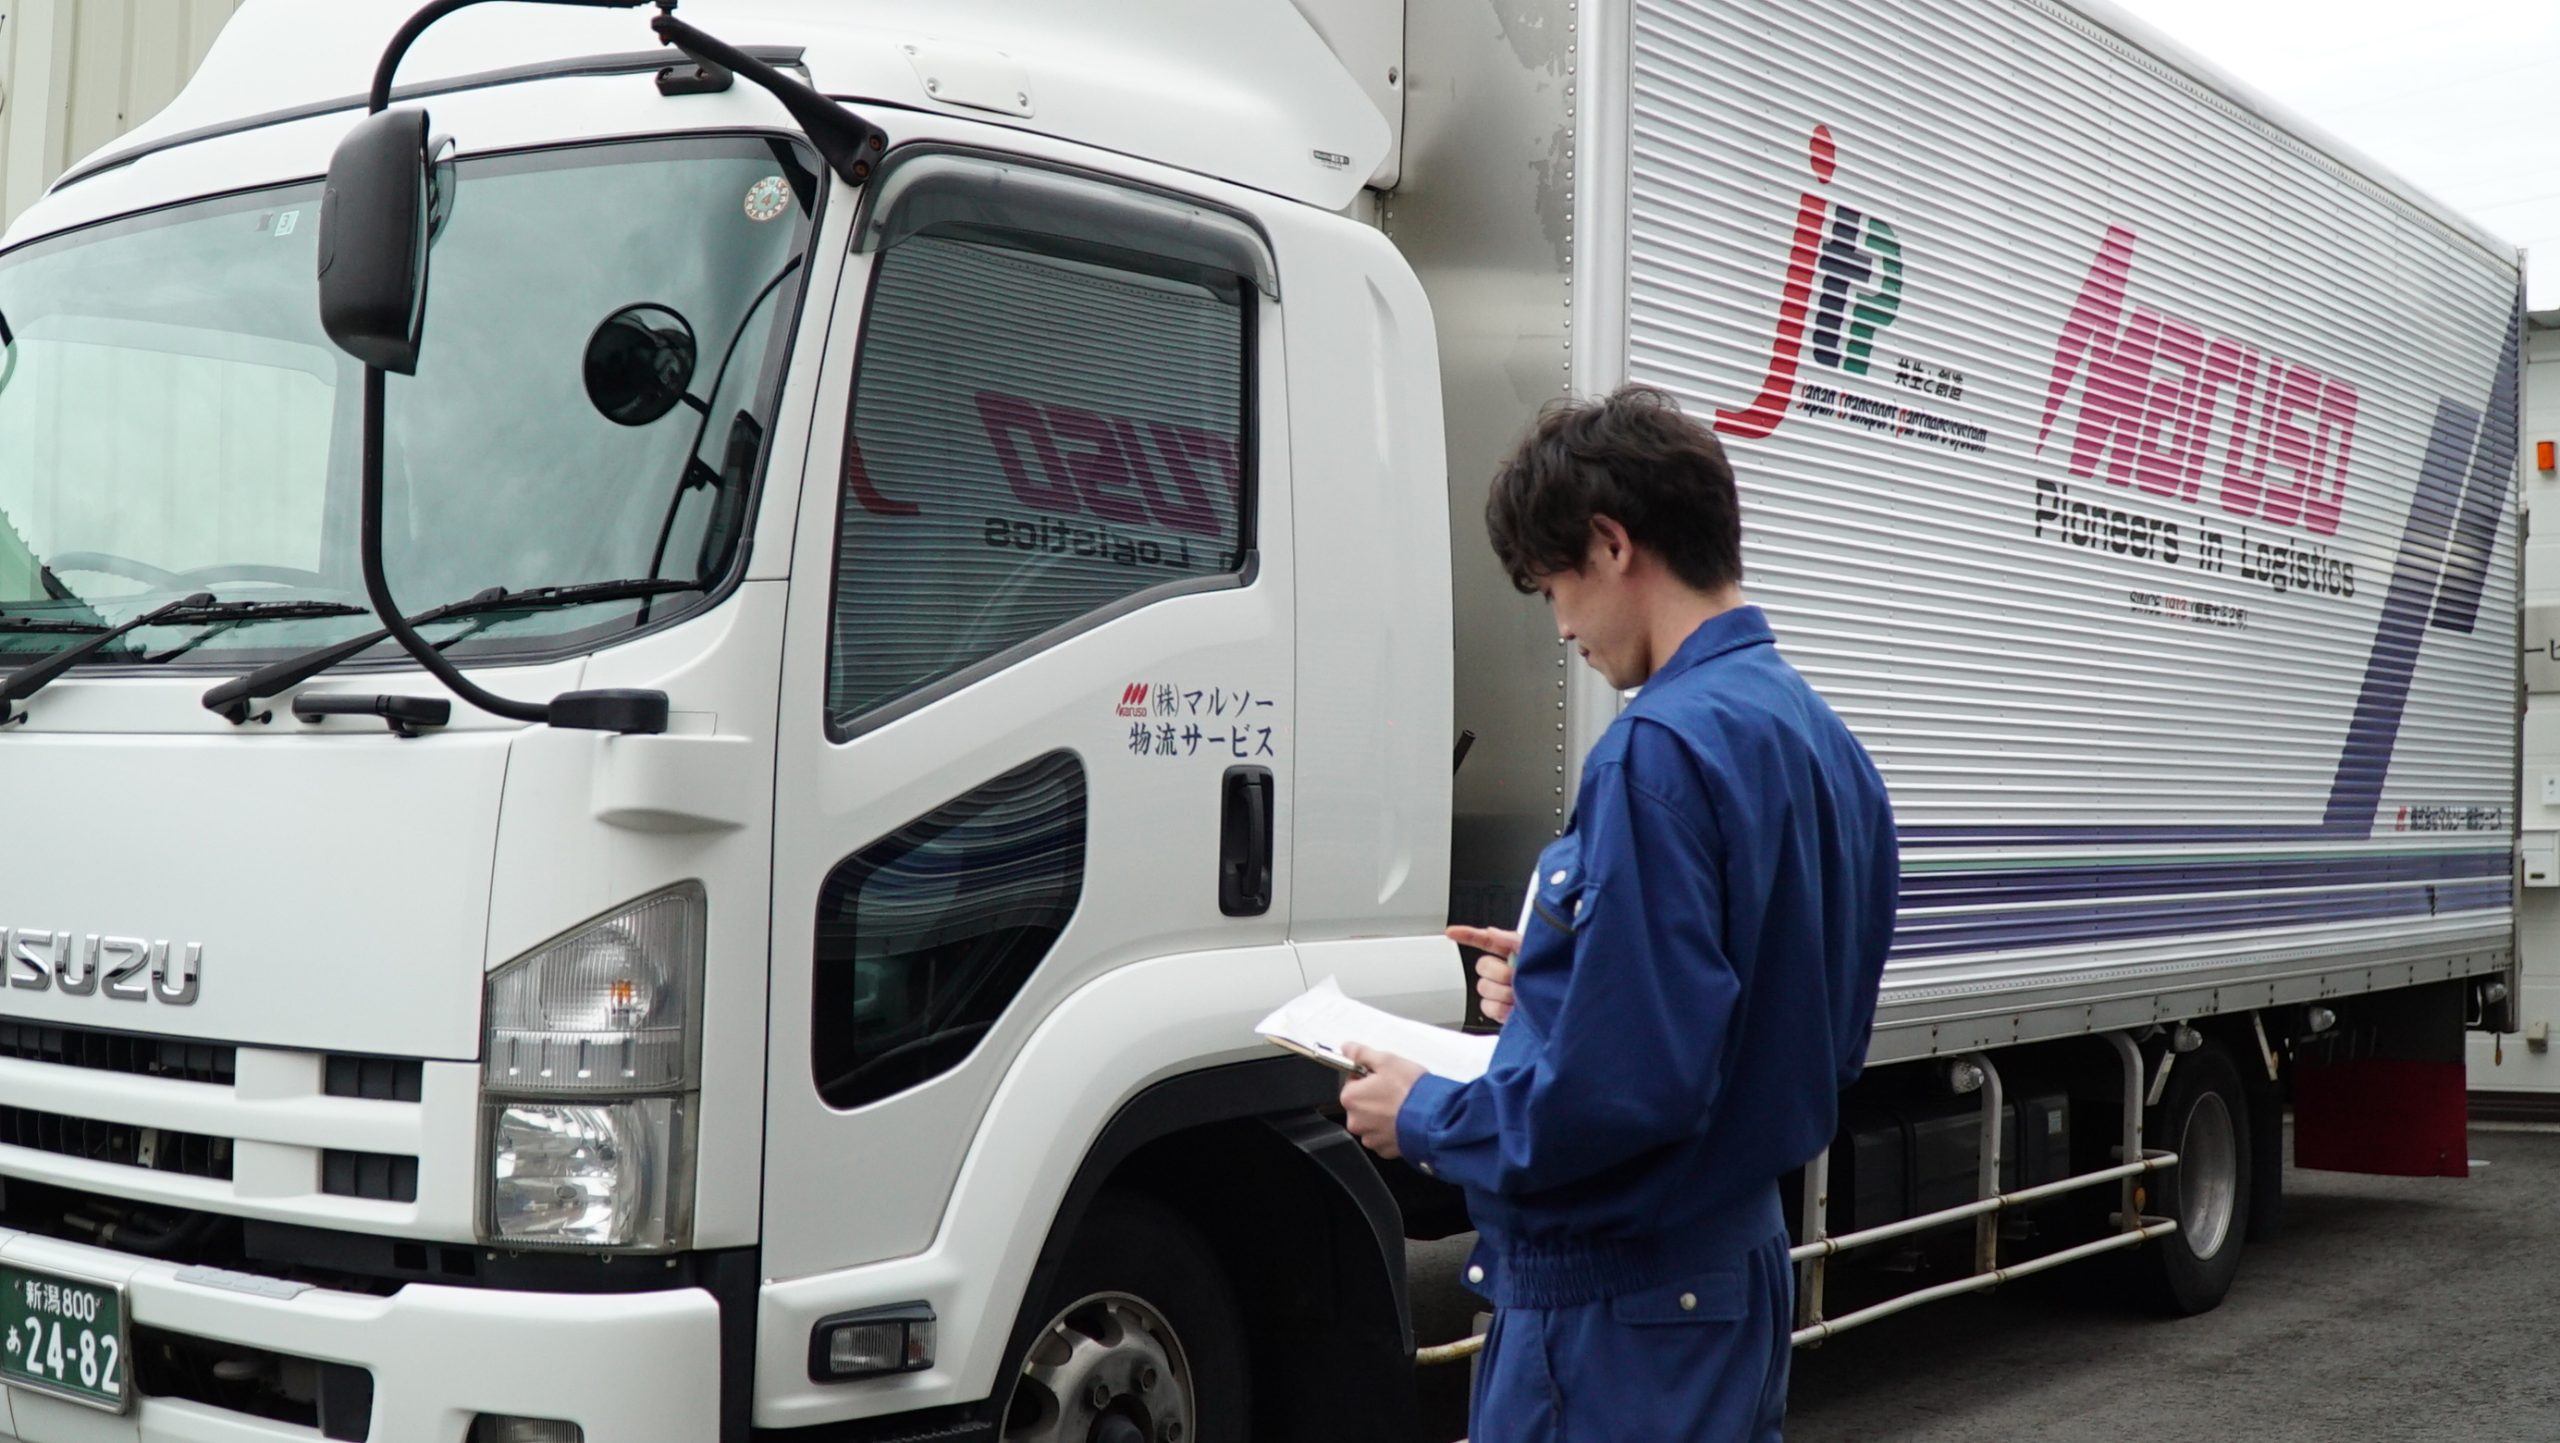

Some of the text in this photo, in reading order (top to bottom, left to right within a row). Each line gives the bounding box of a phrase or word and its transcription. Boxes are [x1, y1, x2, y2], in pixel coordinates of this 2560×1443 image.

[1796, 378, 1837, 417] Japan
[2035, 478, 2355, 599] Pioneers in Logistics
[1151, 682, 1275, 718] (株)マルソー
[1128, 721, 1275, 758] 物流サービス
[6, 1316, 120, 1395] あ 24-82
